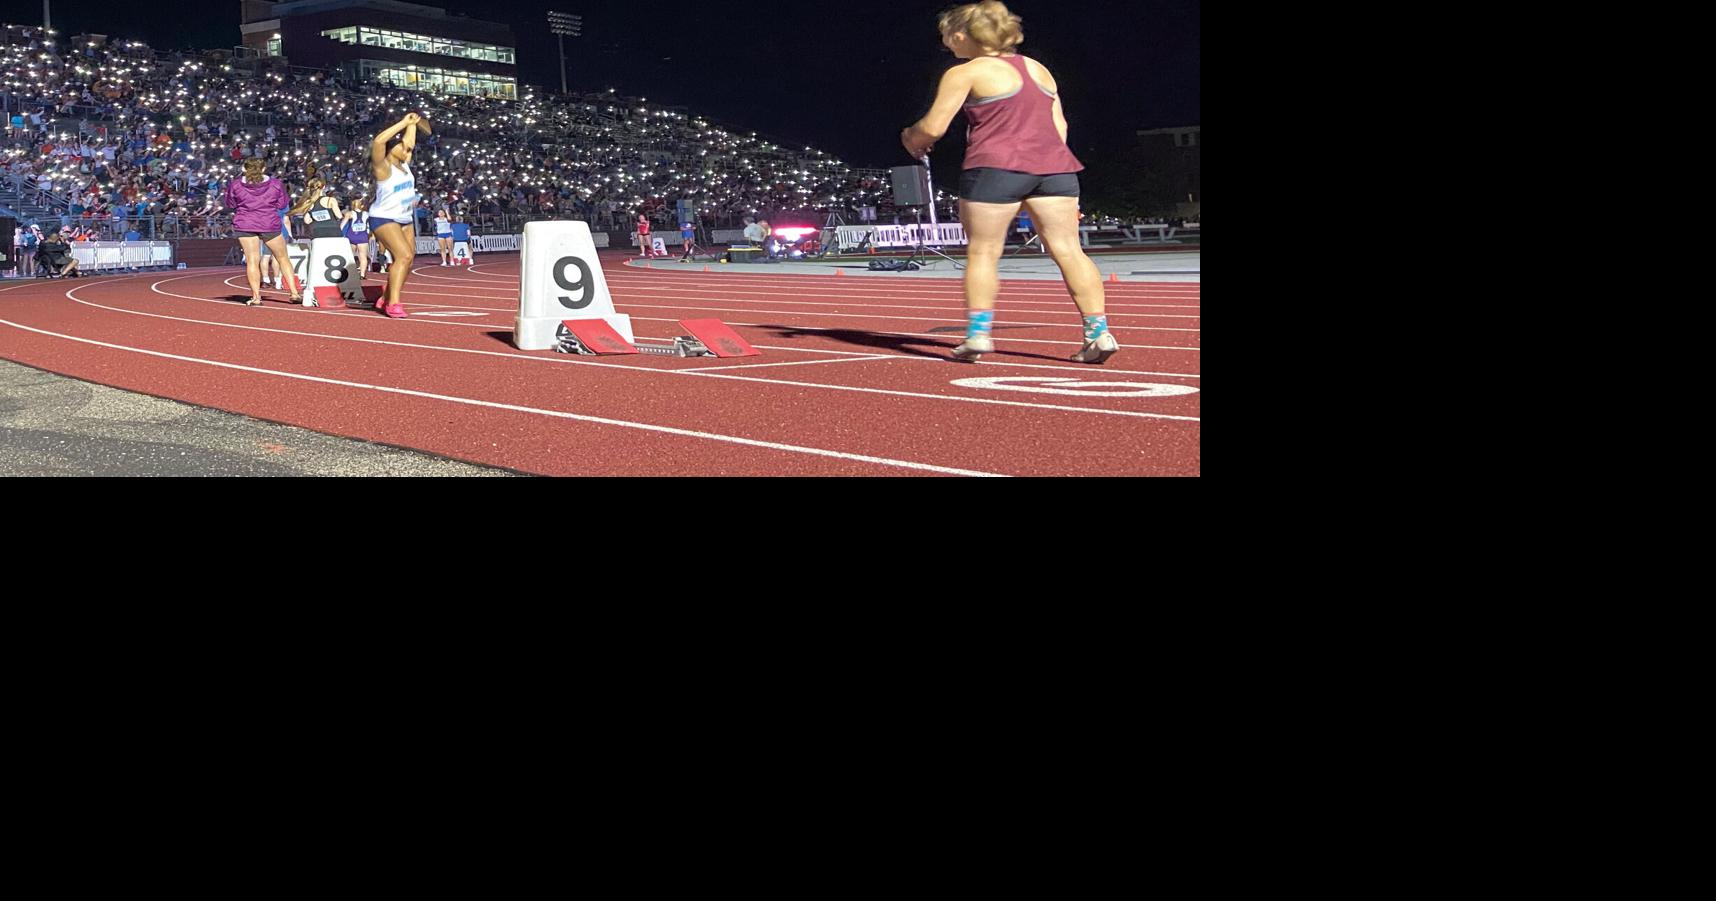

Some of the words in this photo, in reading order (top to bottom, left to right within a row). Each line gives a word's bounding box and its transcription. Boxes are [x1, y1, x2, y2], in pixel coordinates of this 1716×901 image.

[457, 247, 466, 257] 4
[654, 241, 661, 249] 2
[289, 255, 306, 274] 7
[324, 255, 349, 283] 8
[552, 256, 595, 309] 9
